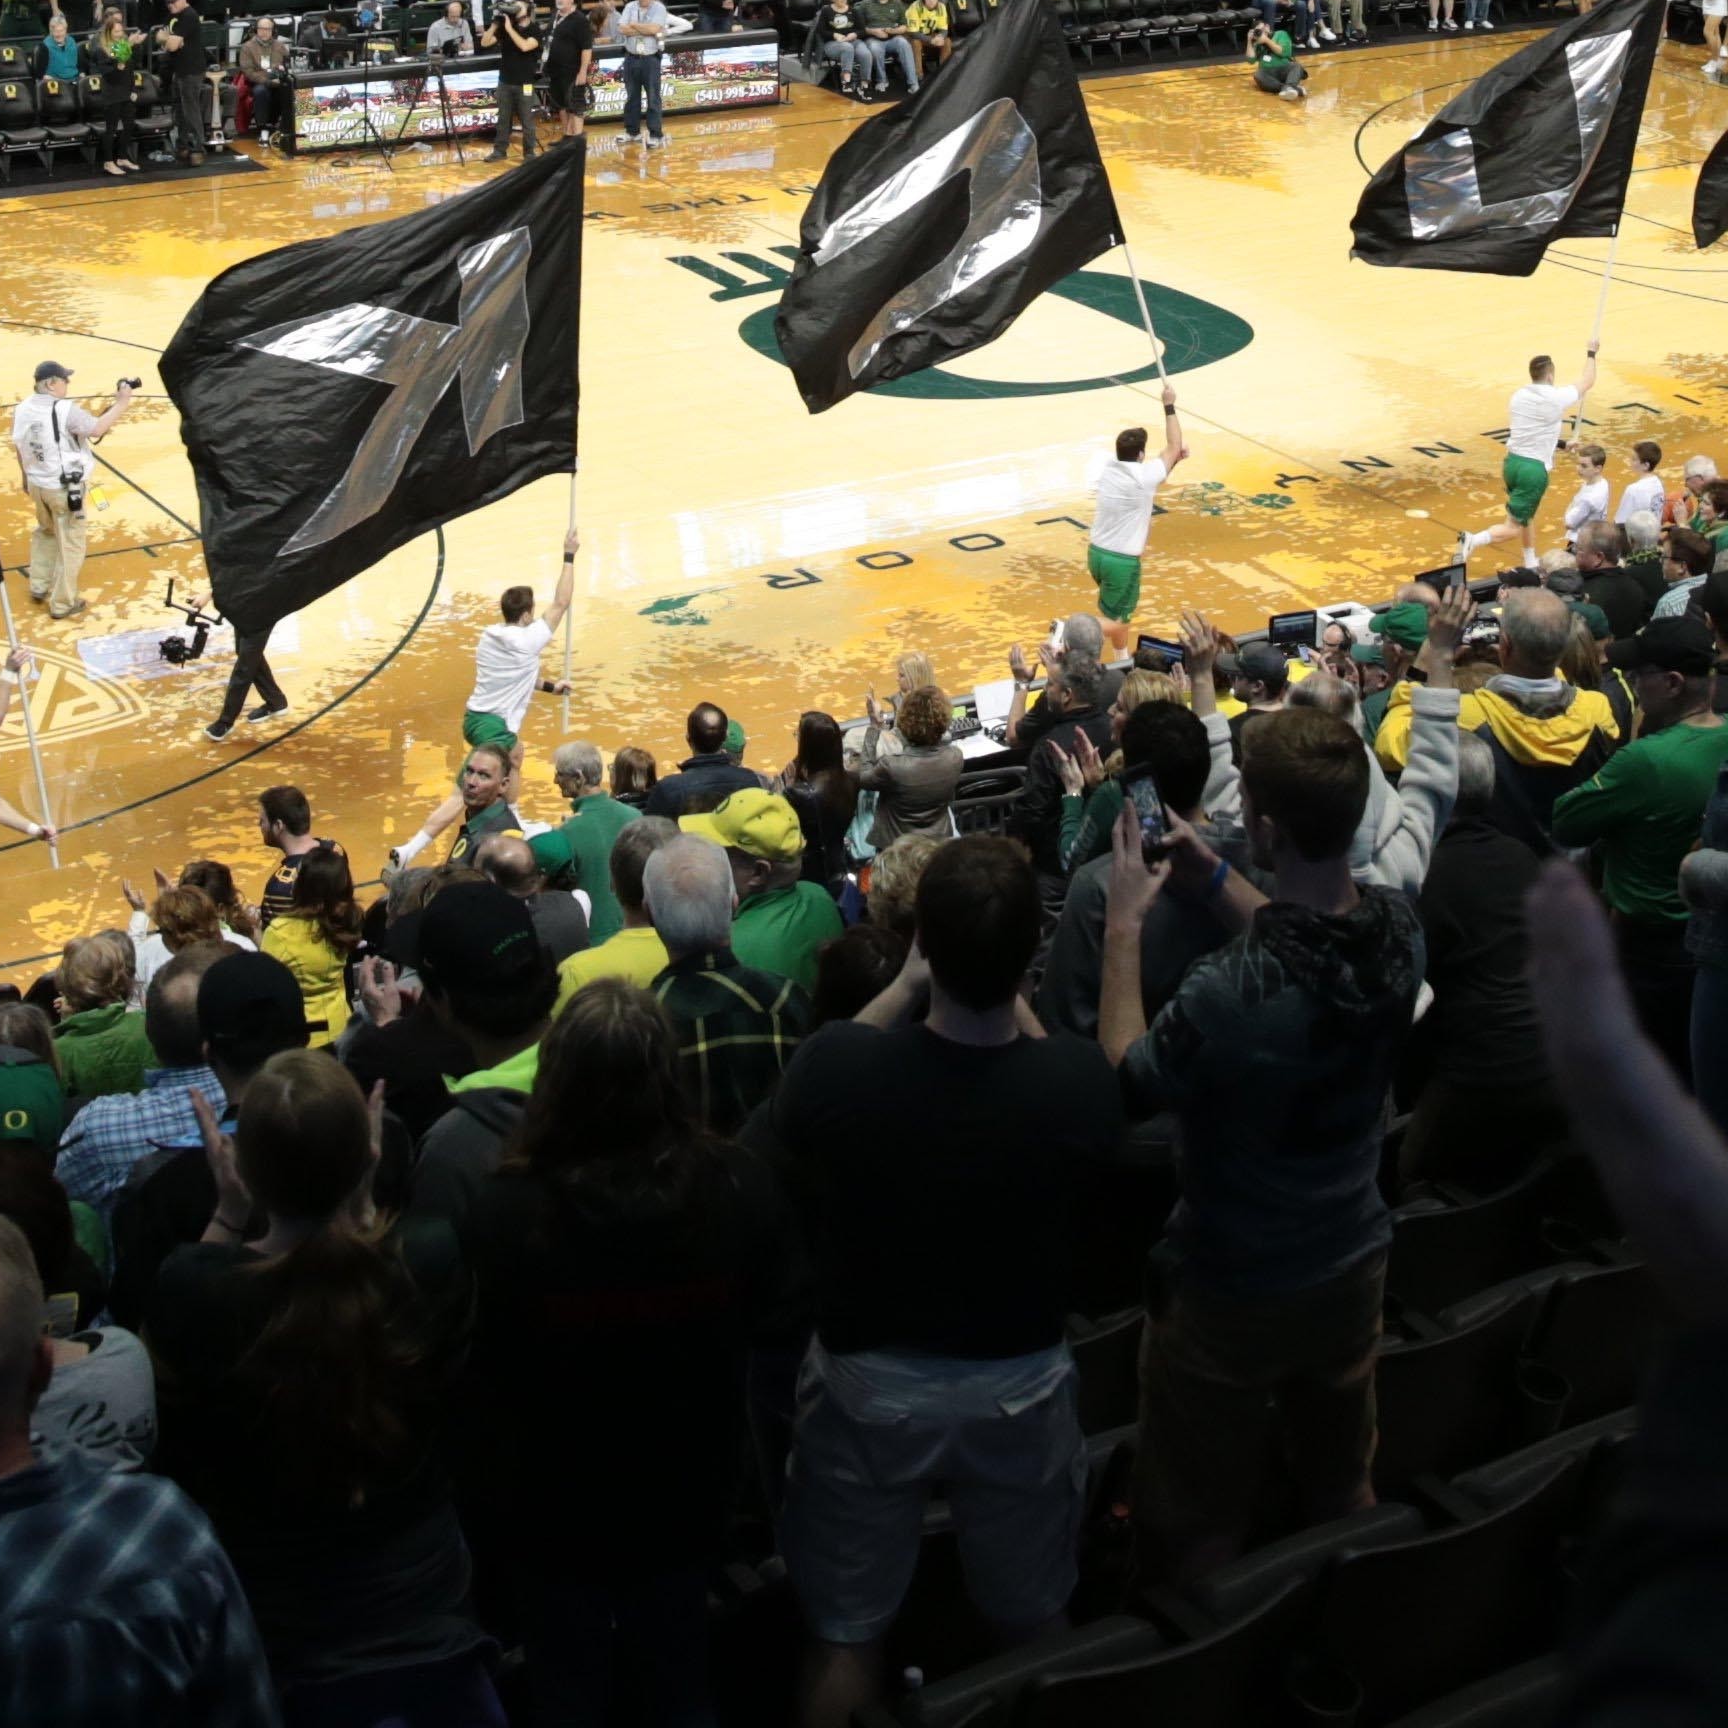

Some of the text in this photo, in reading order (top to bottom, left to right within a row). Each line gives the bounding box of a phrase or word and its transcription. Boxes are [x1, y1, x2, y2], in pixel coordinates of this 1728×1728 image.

[695, 83, 774, 103] (541) 998-2365
[300, 115, 363, 133] Shadow
